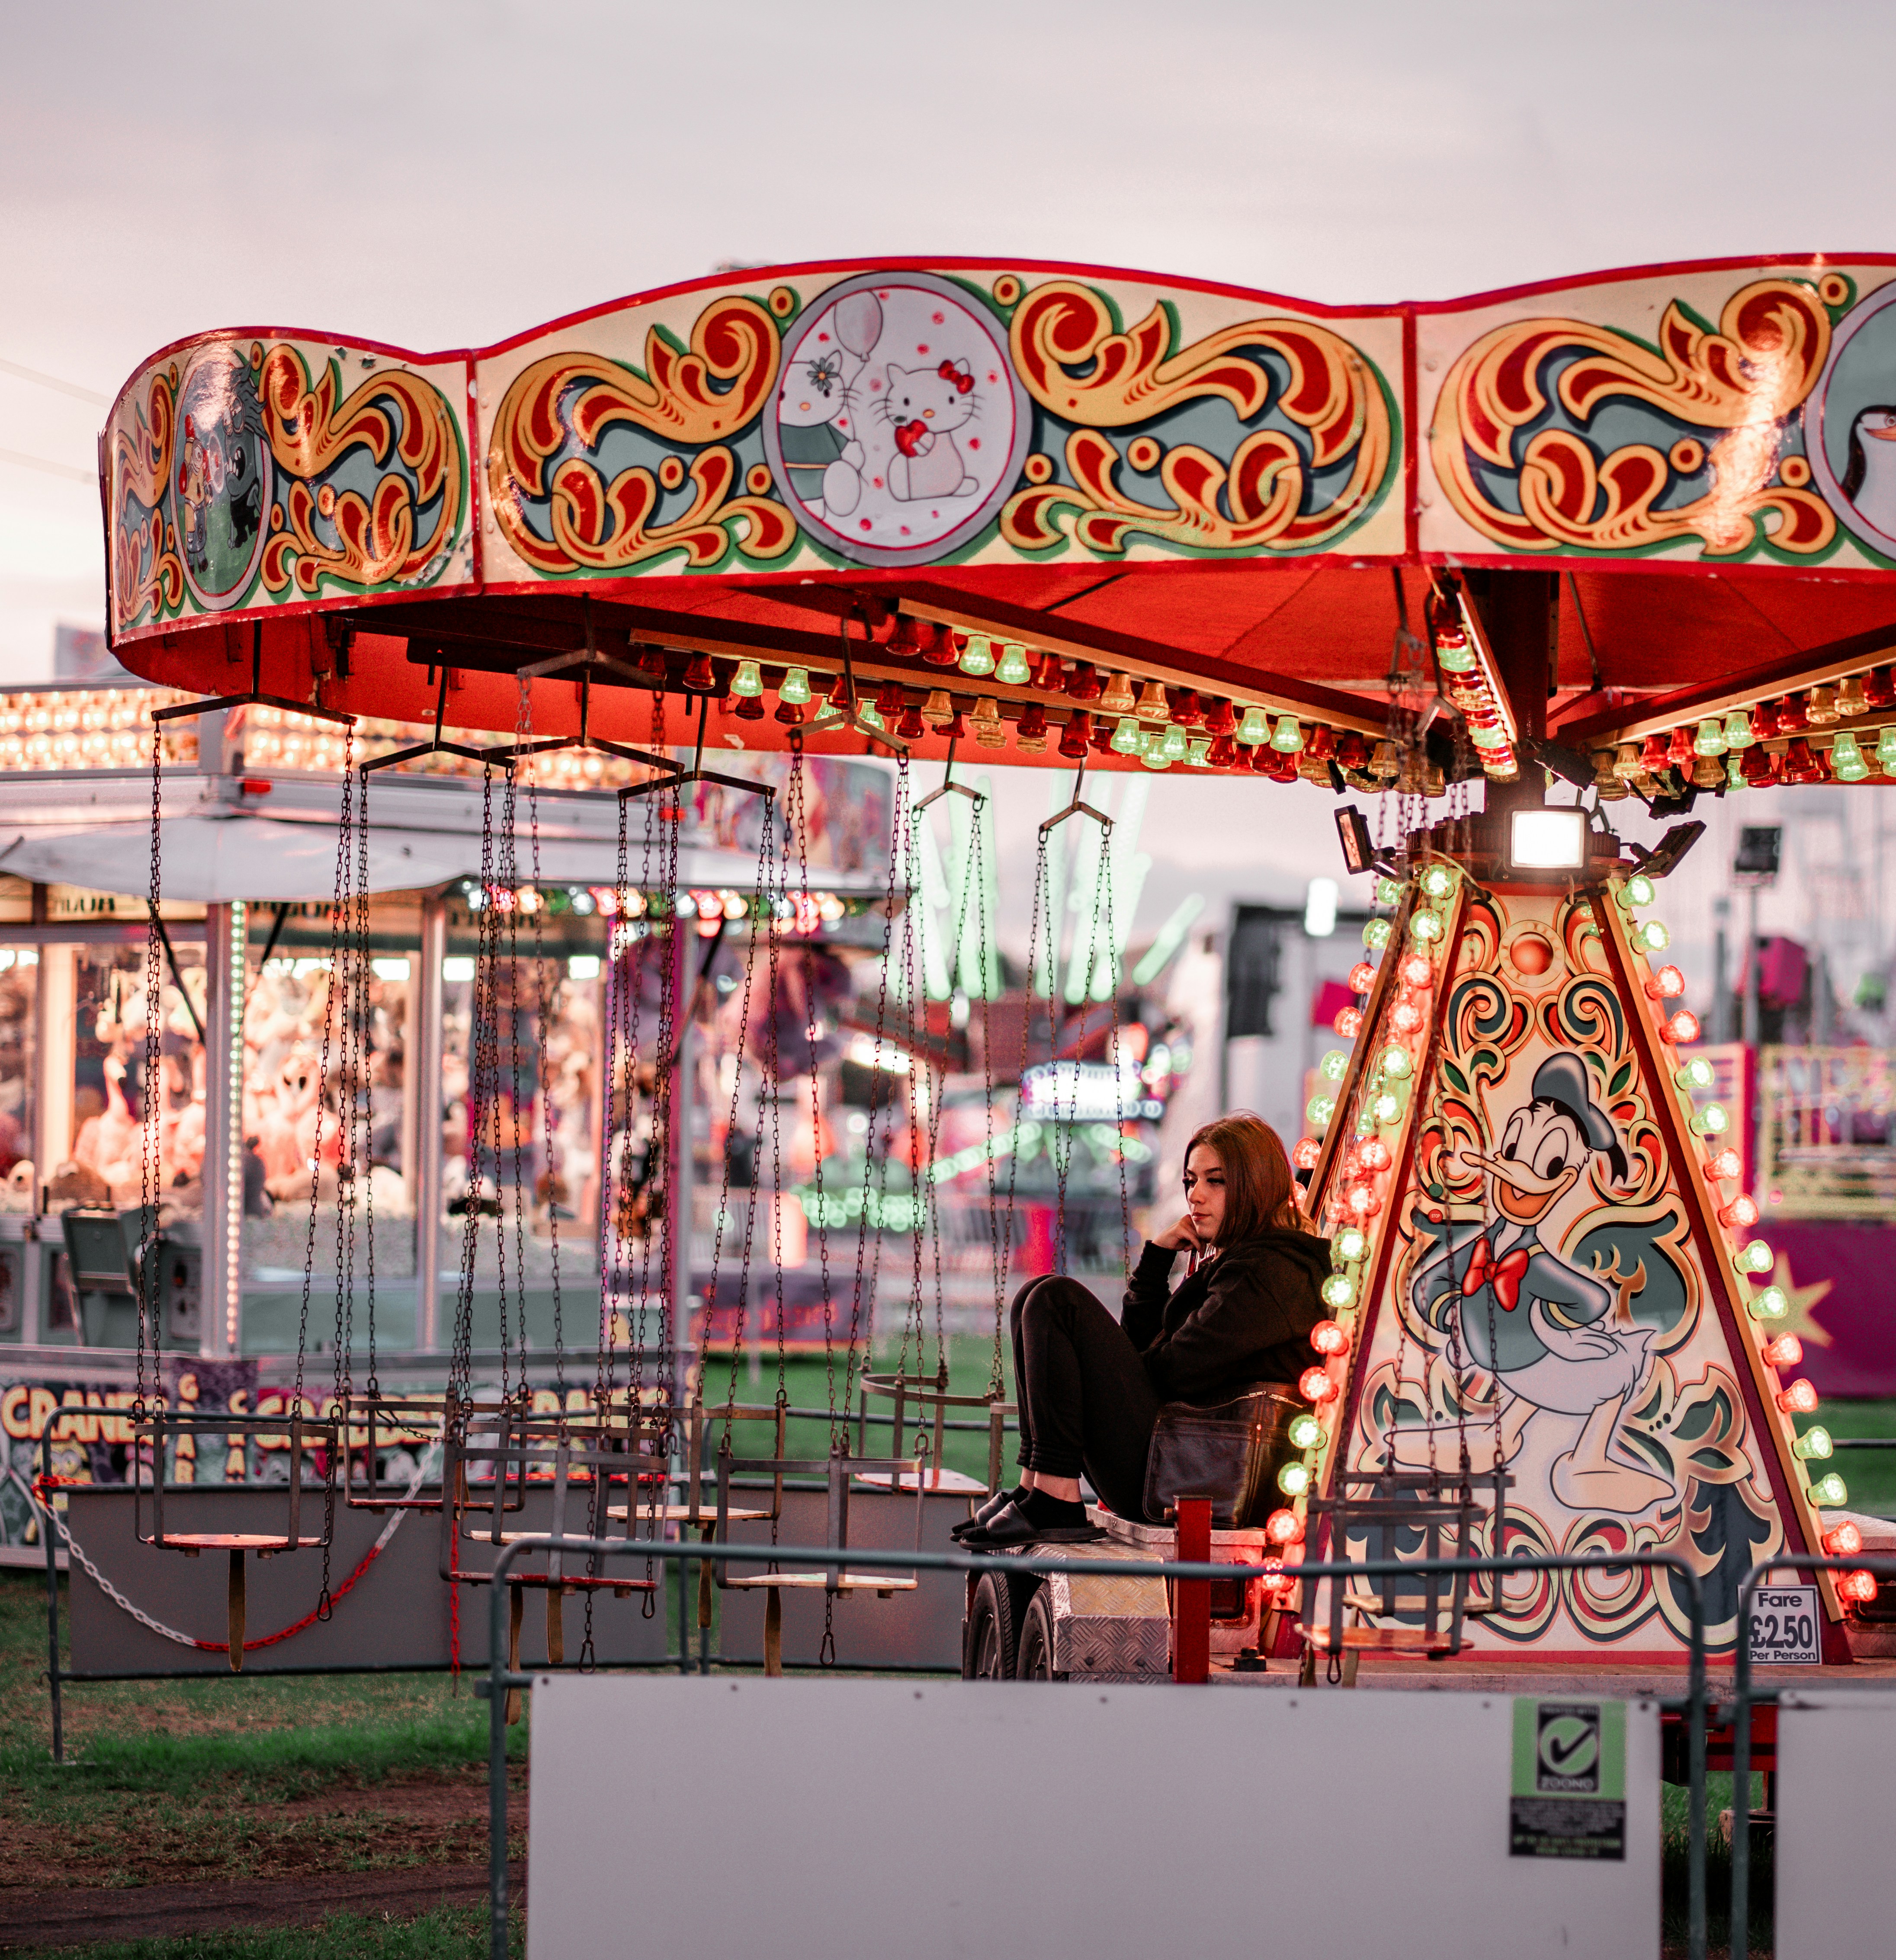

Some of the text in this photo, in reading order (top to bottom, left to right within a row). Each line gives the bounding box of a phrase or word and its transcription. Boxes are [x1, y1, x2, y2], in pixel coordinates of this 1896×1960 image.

[1758, 1592, 1803, 1608] Fare
[1749, 1614, 1813, 1649] £2.50
[1750, 1650, 1816, 1660] Per Person
